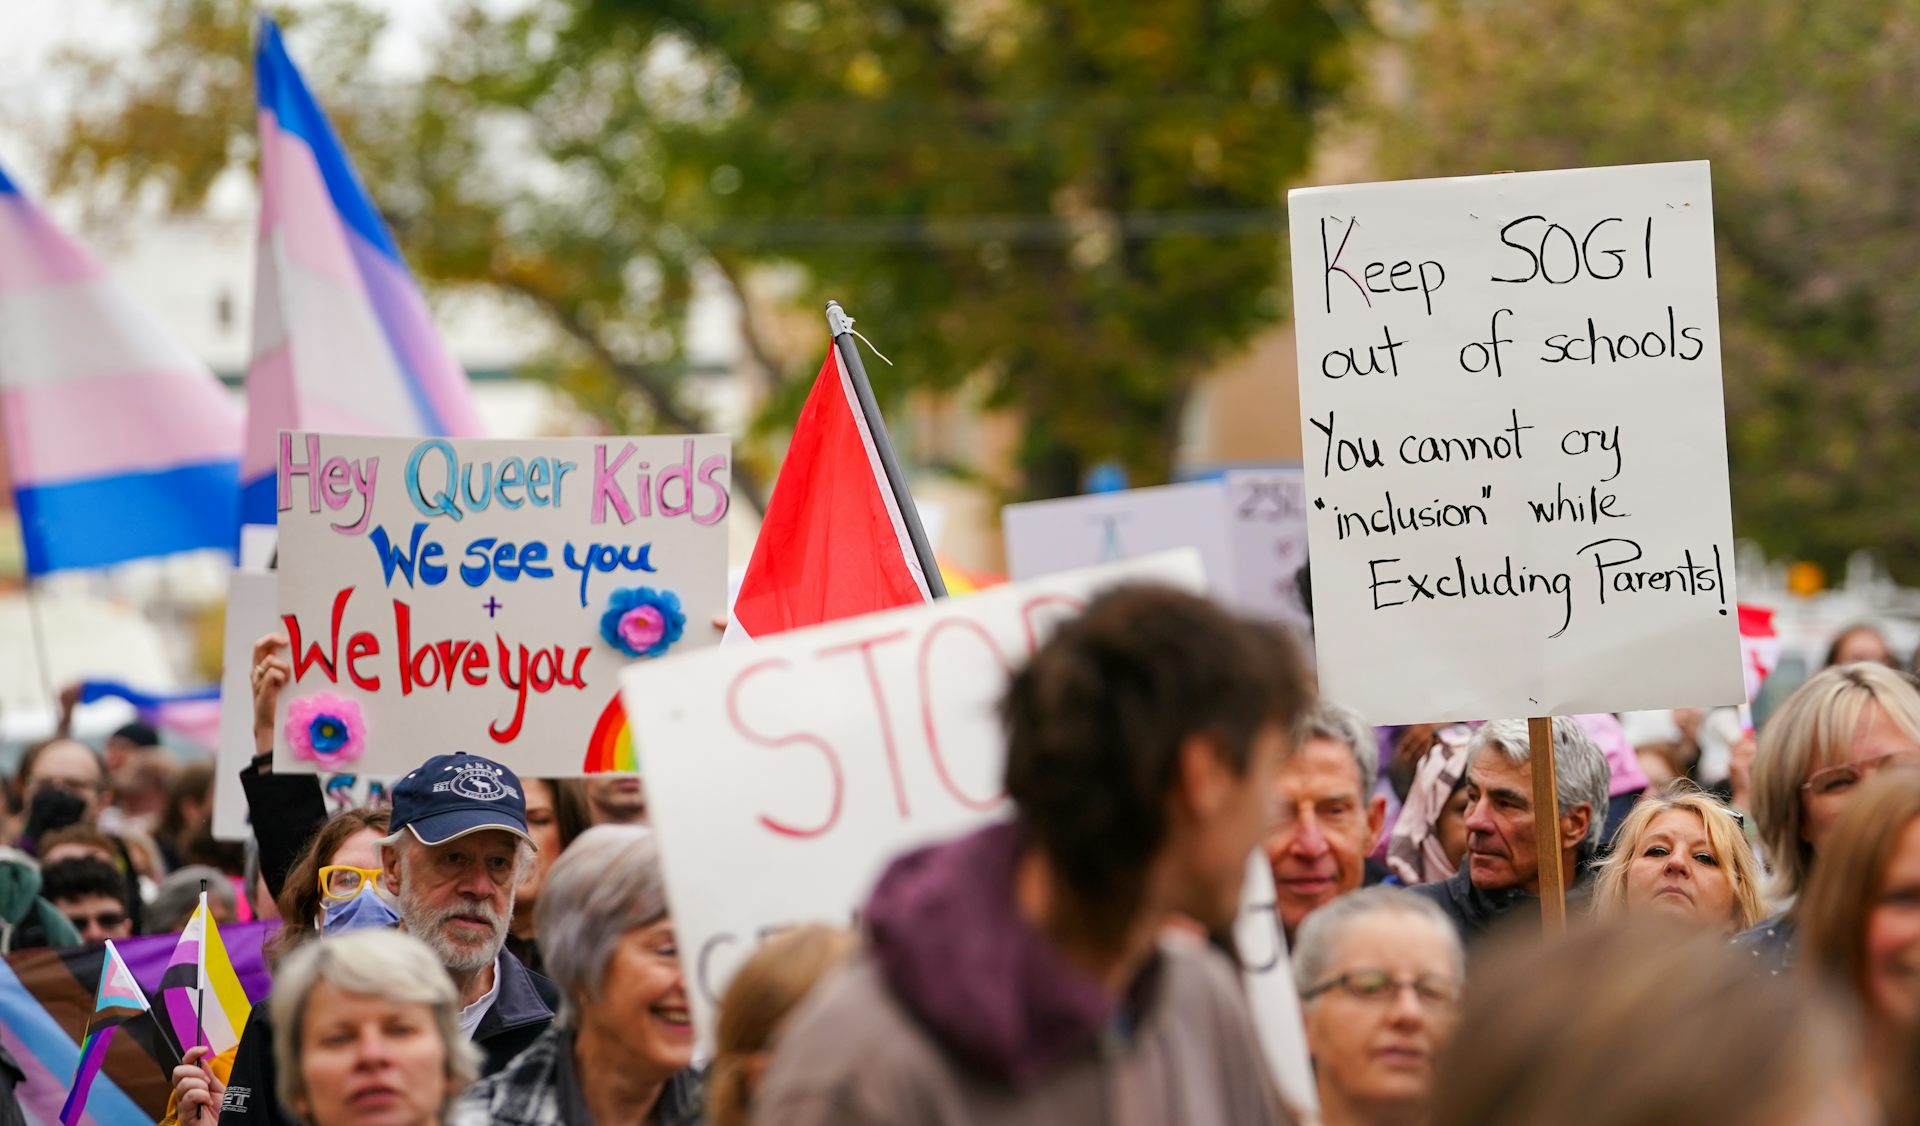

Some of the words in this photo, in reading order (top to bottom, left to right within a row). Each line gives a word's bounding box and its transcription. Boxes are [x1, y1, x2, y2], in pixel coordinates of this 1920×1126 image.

[1320, 215, 1446, 316] Keep
[1490, 216, 1653, 285] SOGI
[1321, 326, 1409, 380] out
[1459, 308, 1514, 378] of
[1540, 306, 1704, 365] schools
[278, 432, 379, 536] Hey
[404, 438, 578, 522] Queer
[590, 438, 730, 526] Kids
[1310, 411, 1385, 478] You
[1399, 409, 1535, 465] cannot
[1561, 425, 1622, 483] cry
[1313, 485, 1492, 541] "inclusion"
[1528, 482, 1631, 525] while
[368, 522, 448, 589] We
[459, 536, 554, 588] see
[562, 541, 658, 609] you
[1367, 555, 1572, 639] Excluding
[1576, 538, 1728, 616] Parents!
[280, 585, 381, 692] We
[393, 597, 490, 697] love
[488, 631, 592, 744] you
